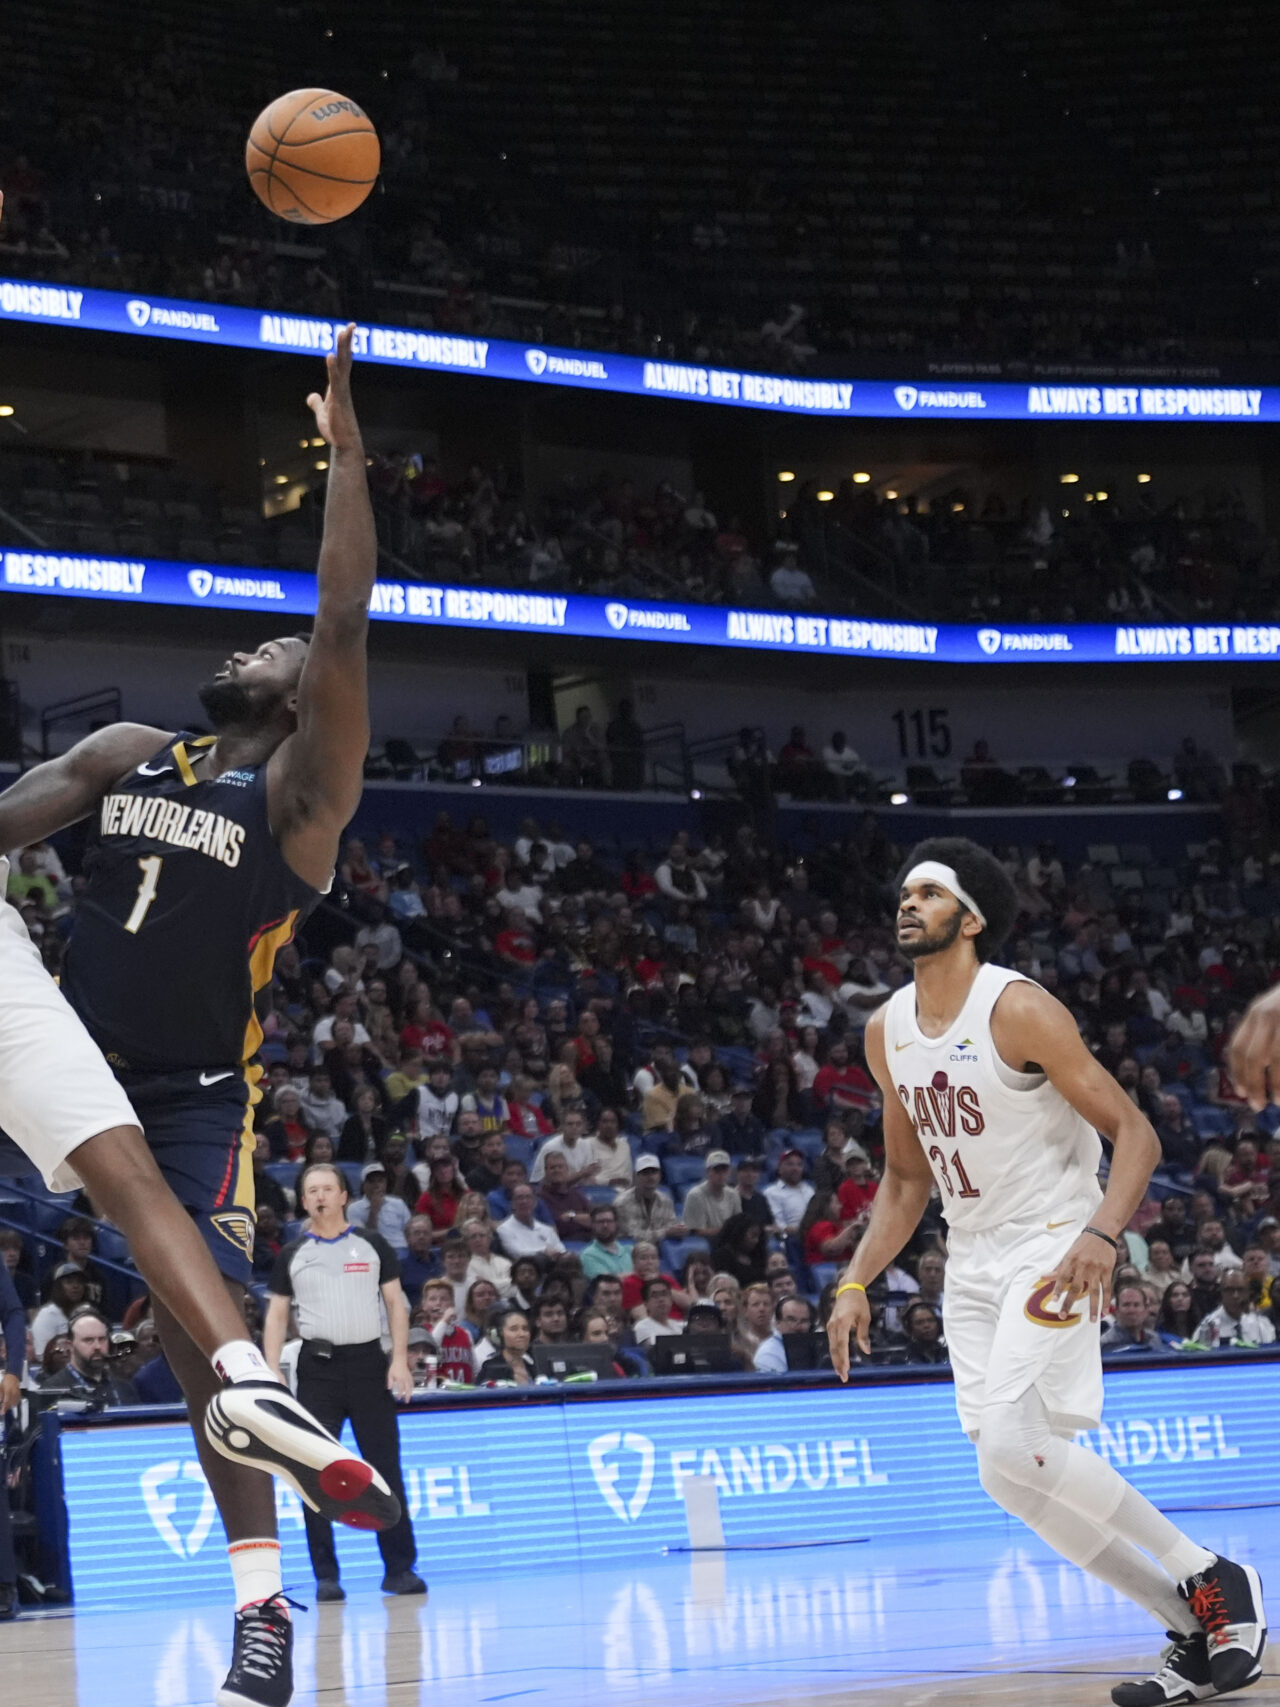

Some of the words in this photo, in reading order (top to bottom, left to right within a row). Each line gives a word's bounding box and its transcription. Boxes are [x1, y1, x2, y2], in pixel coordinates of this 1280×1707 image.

[151, 307, 219, 332] FANDUEL
[260, 315, 333, 351] ALWAYS
[373, 328, 489, 368] RESPONSIBLY
[547, 356, 608, 379] FANDUEL
[643, 362, 708, 396] ALWAYS
[709, 370, 741, 400] BET
[741, 374, 853, 409] RESPONSIBLY
[919, 391, 986, 409] FANDUEL
[1028, 387, 1102, 414] ALWAYS
[1103, 388, 1139, 414] BET
[1140, 388, 1262, 416] RESPONSIBLY
[4, 552, 146, 593] RESPONSIBLY
[213, 576, 286, 600] FANDUEL
[406, 587, 443, 617] BET
[444, 589, 568, 626] RESPONSIBLY
[627, 609, 691, 631] FANDUEL
[727, 610, 794, 644] ALWAYS
[794, 616, 828, 646] BET
[828, 618, 938, 653] RESPONSIBLY
[1002, 633, 1073, 651] FANDUEL
[1115, 627, 1192, 655] ALWAYS
[1193, 627, 1230, 655] BET
[892, 709, 951, 758] 115
[124, 855, 163, 935] 1
[949, 1054, 978, 1062] CLIFFS
[929, 1145, 980, 1198] 31
[1072, 1414, 1240, 1466] ANDUEL
[671, 1439, 888, 1500] FANDUEL
